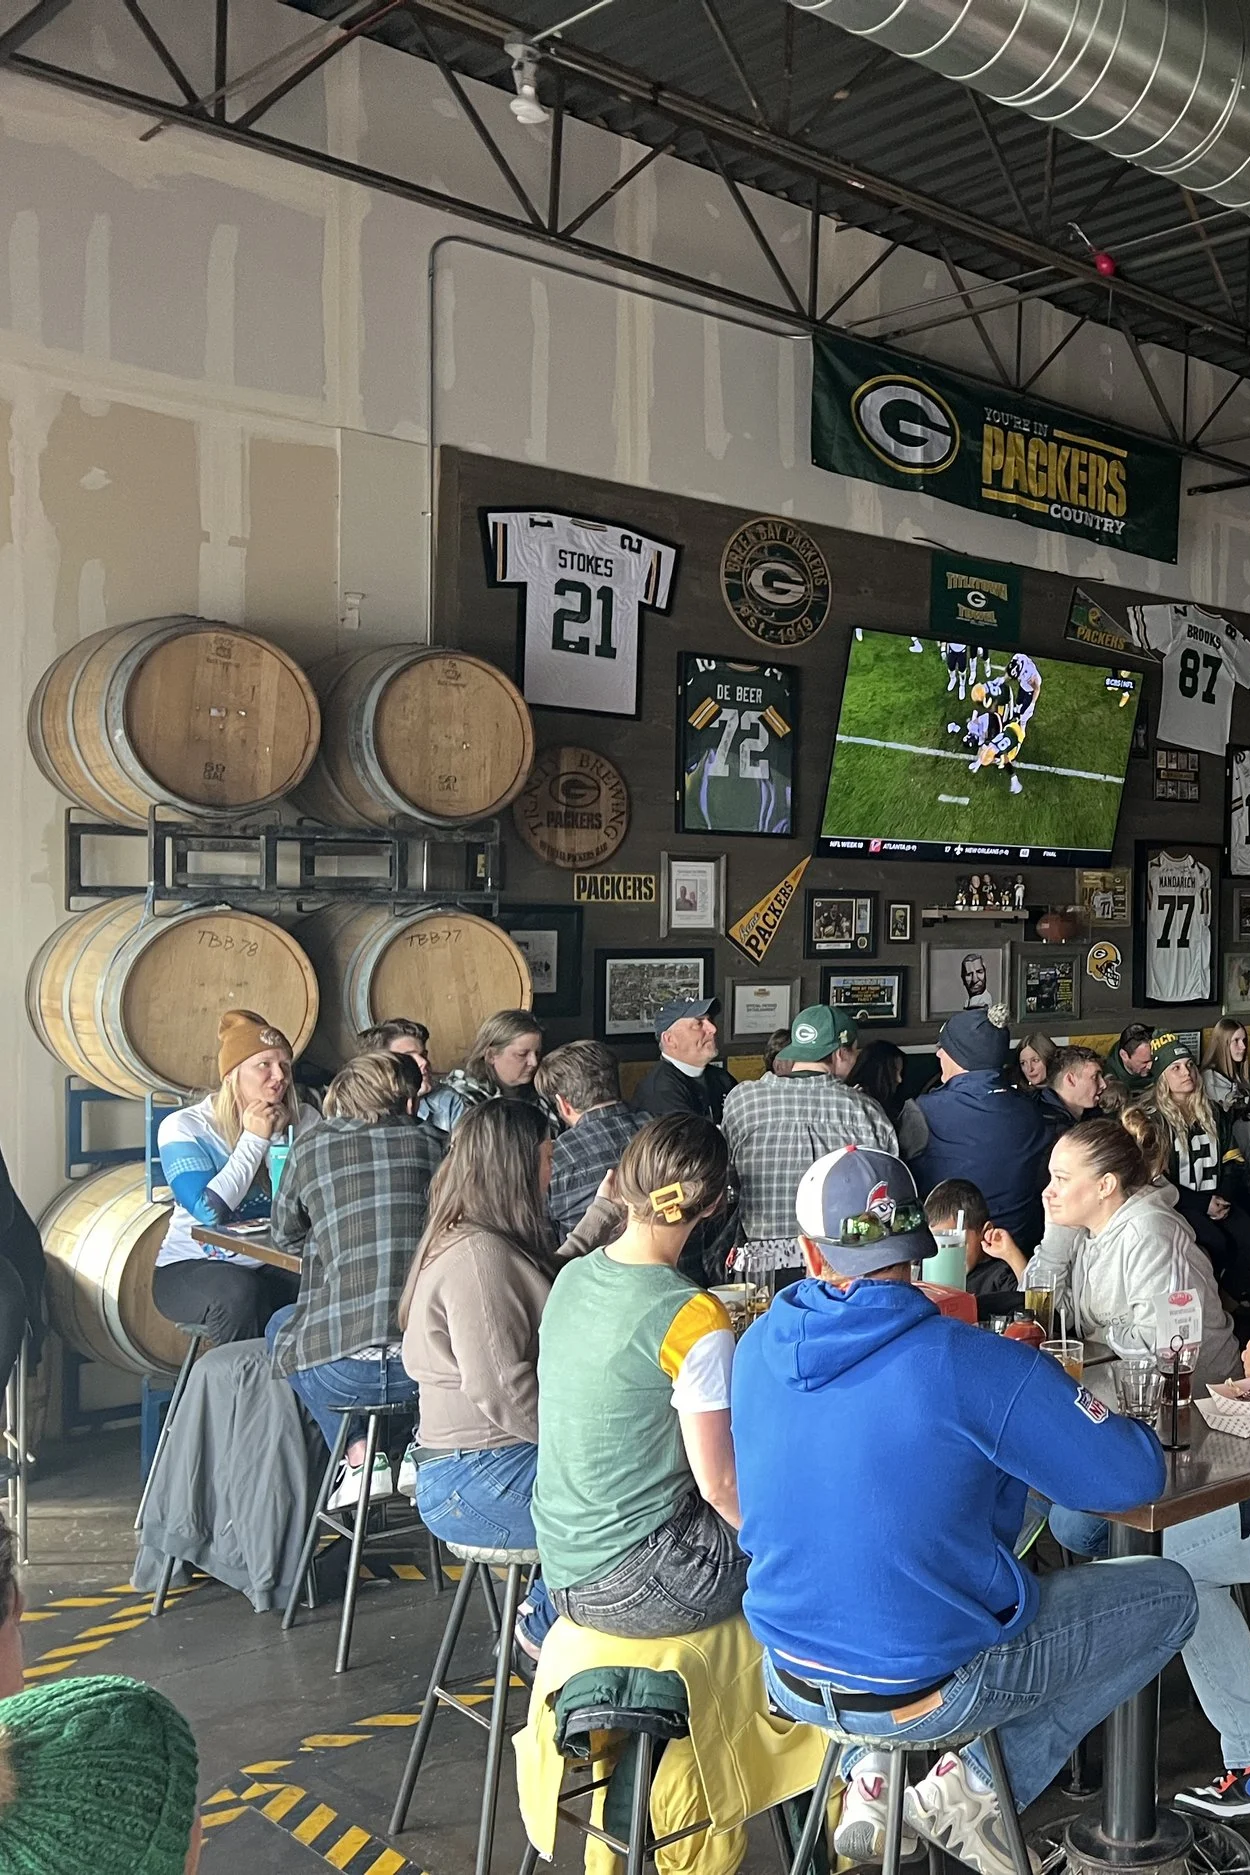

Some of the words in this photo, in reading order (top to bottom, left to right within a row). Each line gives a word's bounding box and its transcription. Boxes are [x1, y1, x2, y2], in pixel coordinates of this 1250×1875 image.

[983, 407, 1030, 433] YOU'RE
[1034, 423, 1049, 436] IN
[982, 424, 1128, 517] PACKERS
[1050, 504, 1127, 535] COUNTRY
[558, 549, 613, 577] STOKES
[785, 527, 828, 586] PACKERS
[552, 578, 617, 659] 21
[1076, 627, 1127, 651] PACKERS
[1187, 624, 1221, 649] BROOKS
[1178, 648, 1223, 704] 87
[717, 684, 731, 700] DE
[736, 686, 763, 703] BEER
[709, 708, 769, 779] 72
[578, 754, 627, 840] BREWING
[546, 811, 603, 829] PACKERS
[829, 840, 841, 848] NFL
[576, 875, 654, 900] PACKERS
[1158, 874, 1196, 889] MANDARICH
[745, 881, 794, 958] PACKERS
[1156, 895, 1196, 948] 77
[1174, 1134, 1219, 1191] 12
